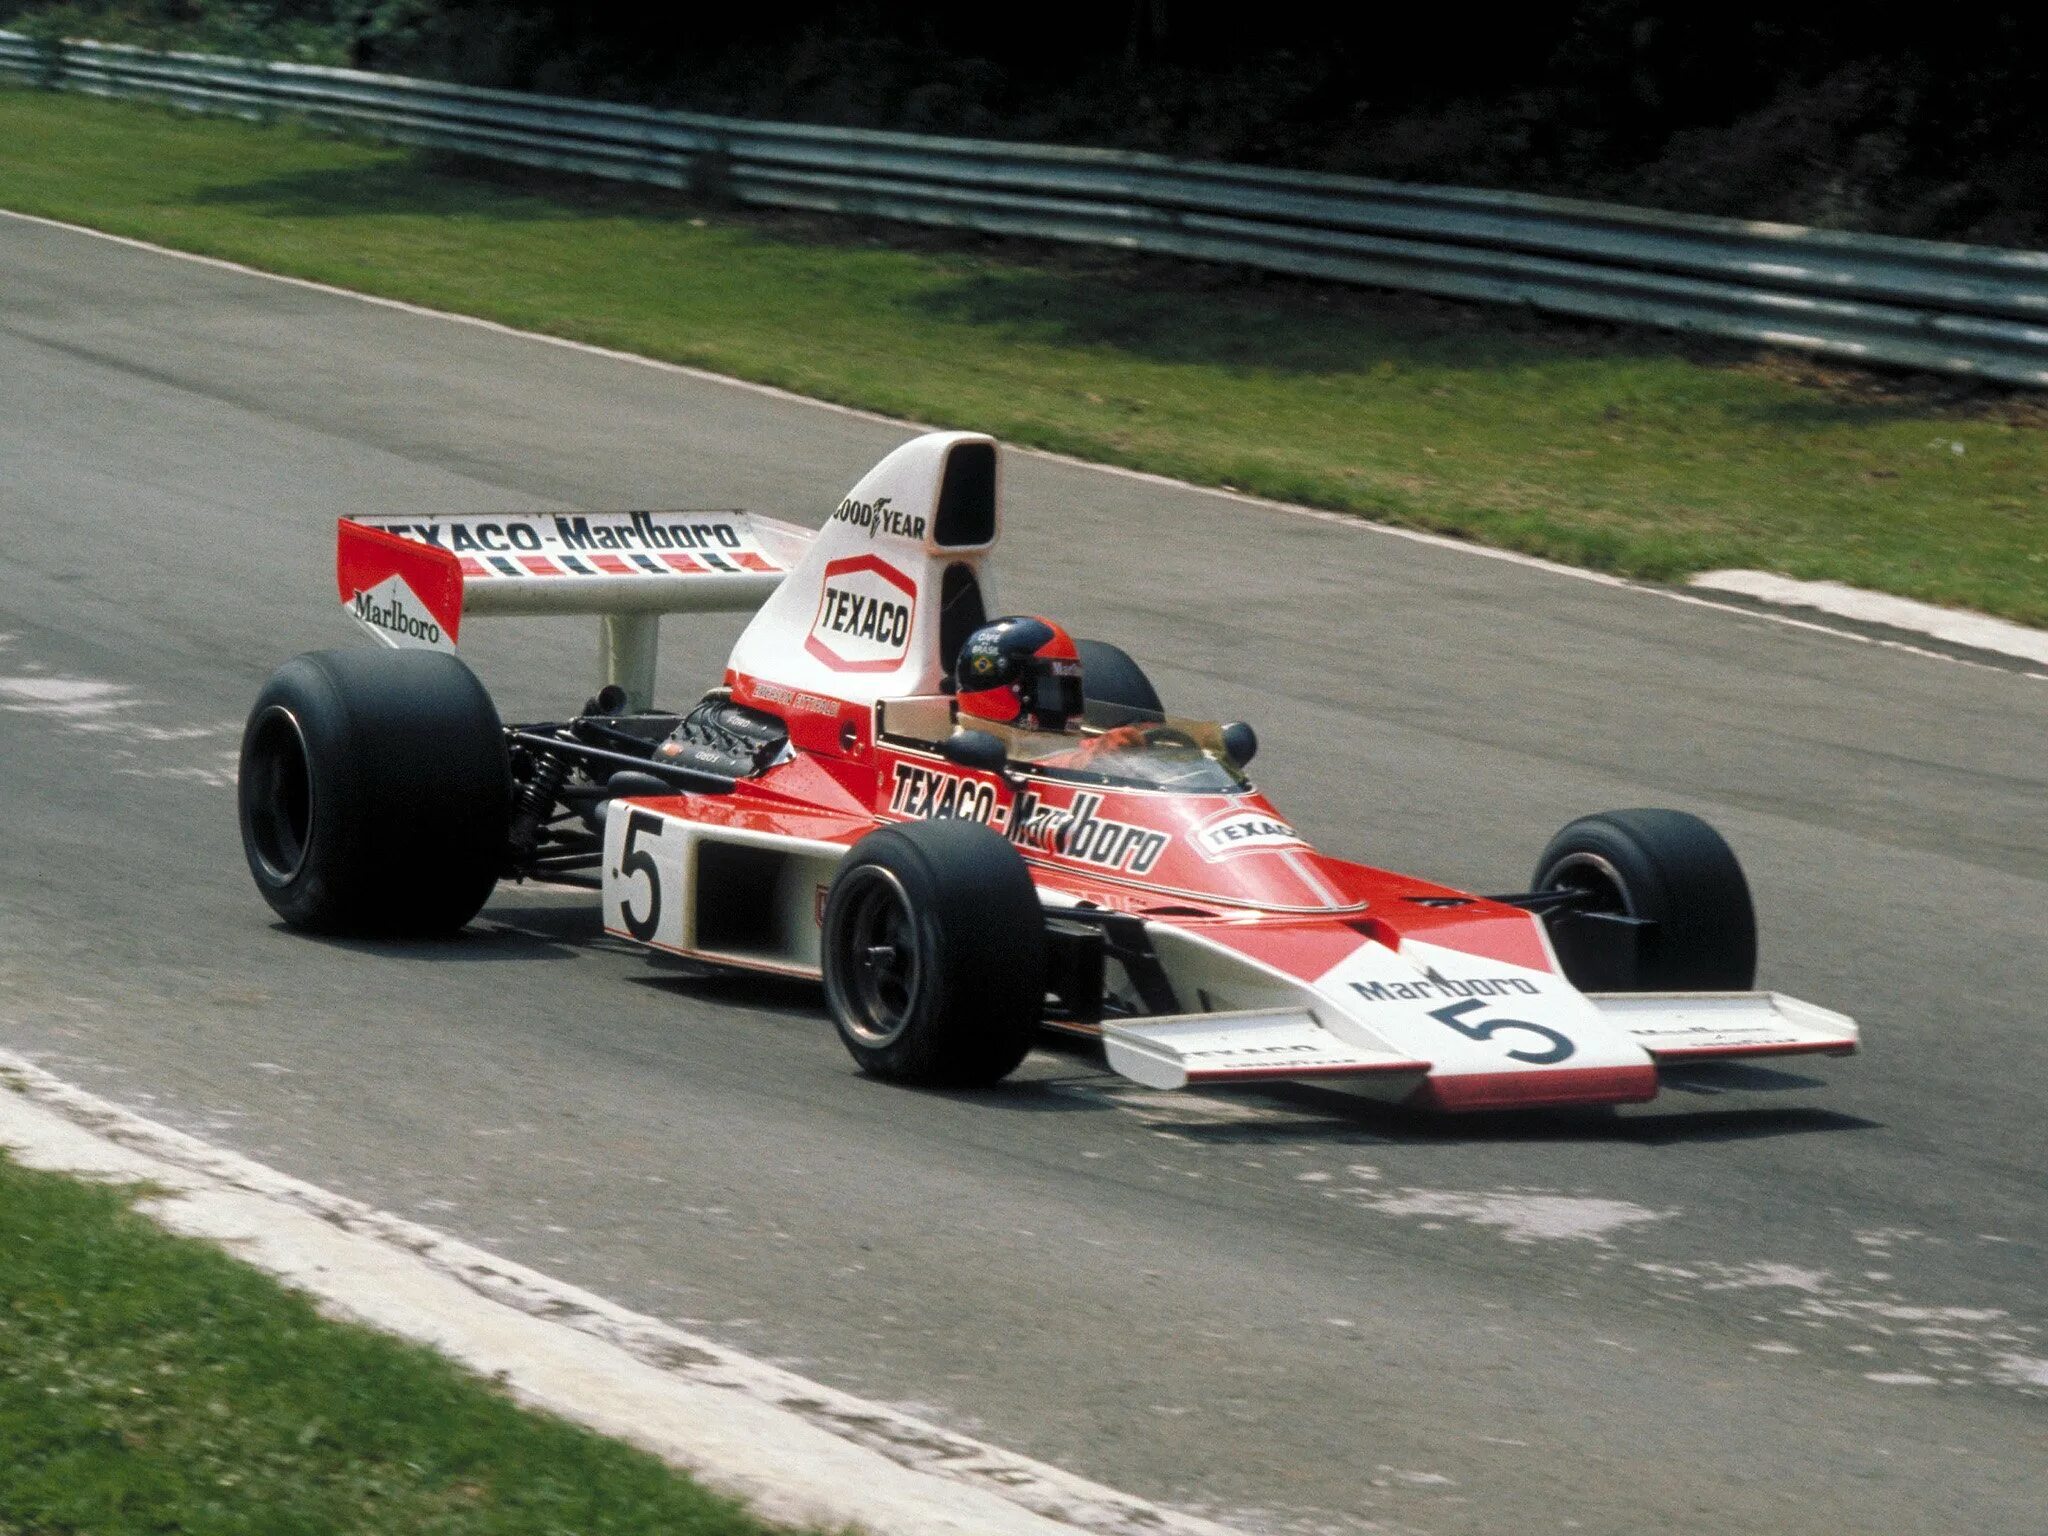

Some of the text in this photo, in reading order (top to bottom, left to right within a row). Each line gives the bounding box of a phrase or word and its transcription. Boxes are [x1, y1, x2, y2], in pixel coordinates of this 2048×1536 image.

[833, 497, 926, 540] OODYEAR
[354, 590, 440, 644] Marlboro
[821, 587, 908, 648] TEXACO
[1208, 821, 1299, 845] TEXAC
[620, 810, 662, 942] 5
[1349, 966, 1541, 1001] Marlboro
[1427, 998, 1577, 1065] 5
